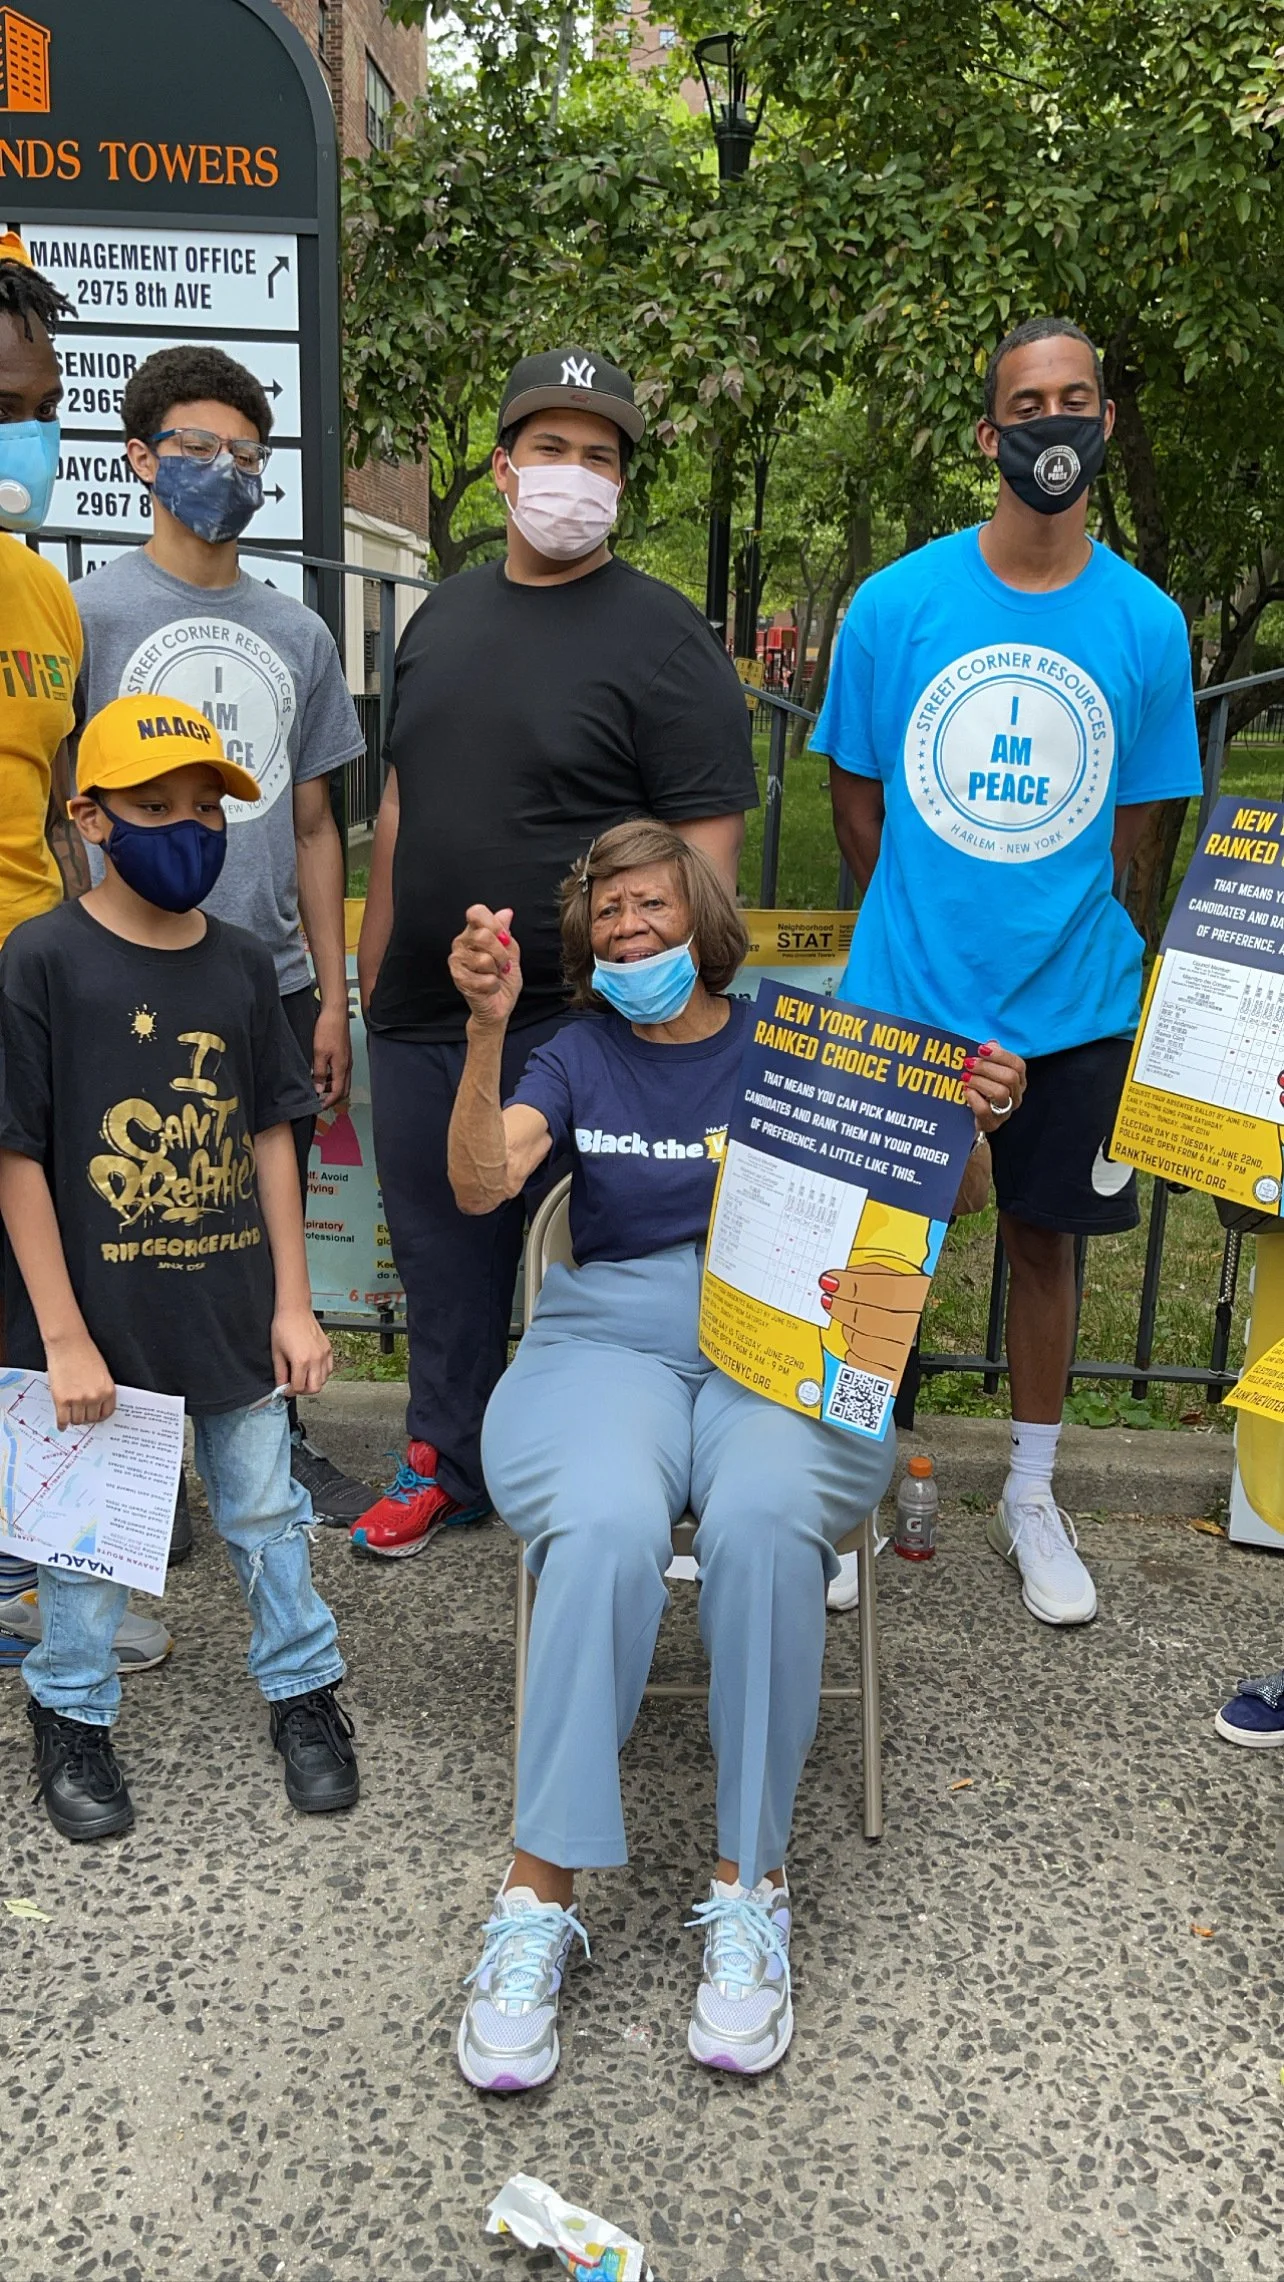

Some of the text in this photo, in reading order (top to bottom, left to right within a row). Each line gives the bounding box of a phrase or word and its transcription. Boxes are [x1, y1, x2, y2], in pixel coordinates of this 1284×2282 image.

[0, 139, 279, 187] NDS TOWERS
[30, 241, 256, 275] MANAGEMENT OFFICE
[77, 280, 212, 309] 2975 8th AVE
[561, 356, 596, 388] NY
[68, 388, 125, 414] 2965
[1048, 472, 1067, 480] PEACE
[77, 491, 131, 516] 2967
[127, 625, 292, 713] STREET CORNER RESOURCES
[215, 667, 222, 693] I
[917, 652, 1106, 741] STREET CORNER RESOURCES
[1011, 696, 1019, 725] I
[137, 716, 211, 744] NAACP
[990, 734, 1032, 766] AM
[968, 772, 1050, 805] PEACE
[1232, 808, 1278, 834] NEW
[951, 823, 1064, 854] HARLEM NEW YORK
[1204, 833, 1279, 865] RANKED
[1214, 879, 1238, 893] THAT
[1238, 884, 1273, 901] MEANS
[1189, 899, 1246, 921] CANDIDATES
[1248, 911, 1269, 925] AND
[777, 933, 833, 948] STAT
[778, 923, 833, 931] Neighborhood
[1196, 925, 1211, 937] OF
[1211, 928, 1276, 954] PREFERENCE,
[775, 995, 967, 1070] NEW YORK NOW HAS
[754, 1021, 819, 1060] RANKED
[821, 1043, 891, 1083] CHOICE
[764, 1071, 938, 1135] THAT MEANS YOU CAN PICK MULTIPLE
[1194, 1106, 1215, 1118] BALLOT
[1226, 1115, 1241, 1125] JUNE
[745, 1090, 950, 1166] CANDIDATES AND RANK THEM IN YOUR ORDER
[575, 1129, 649, 1157] Black
[653, 1139, 703, 1159] the
[751, 1117, 922, 1185] OF PREFERENCE, A LITTLE LIKE THIS...
[1119, 1127, 1247, 1175] POLLS ARE OPEN FROM 6 AM 9 PM
[1121, 1116, 1154, 1135] ELECTION
[1154, 1127, 1170, 1138] DAY
[1171, 1132, 1178, 1141] IS
[1218, 1147, 1239, 1161] JUNE
[1240, 1154, 1264, 1170] 22ND,
[321, 1172, 348, 1182] Avoid
[101, 1243, 140, 1263] RIP
[141, 1235, 219, 1257] GEORGE
[349, 1289, 359, 1302] 6
[732, 1342, 747, 1356] FROM
[748, 1351, 753, 1359] 6
[754, 1354, 765, 1366] AM
[772, 1361, 776, 1369] 9
[778, 1365, 790, 1376] PM
[764, 1347, 782, 1361] JUNE
[907, 1518, 922, 1532] G
[125, 1557, 163, 1571] ARAVAN
